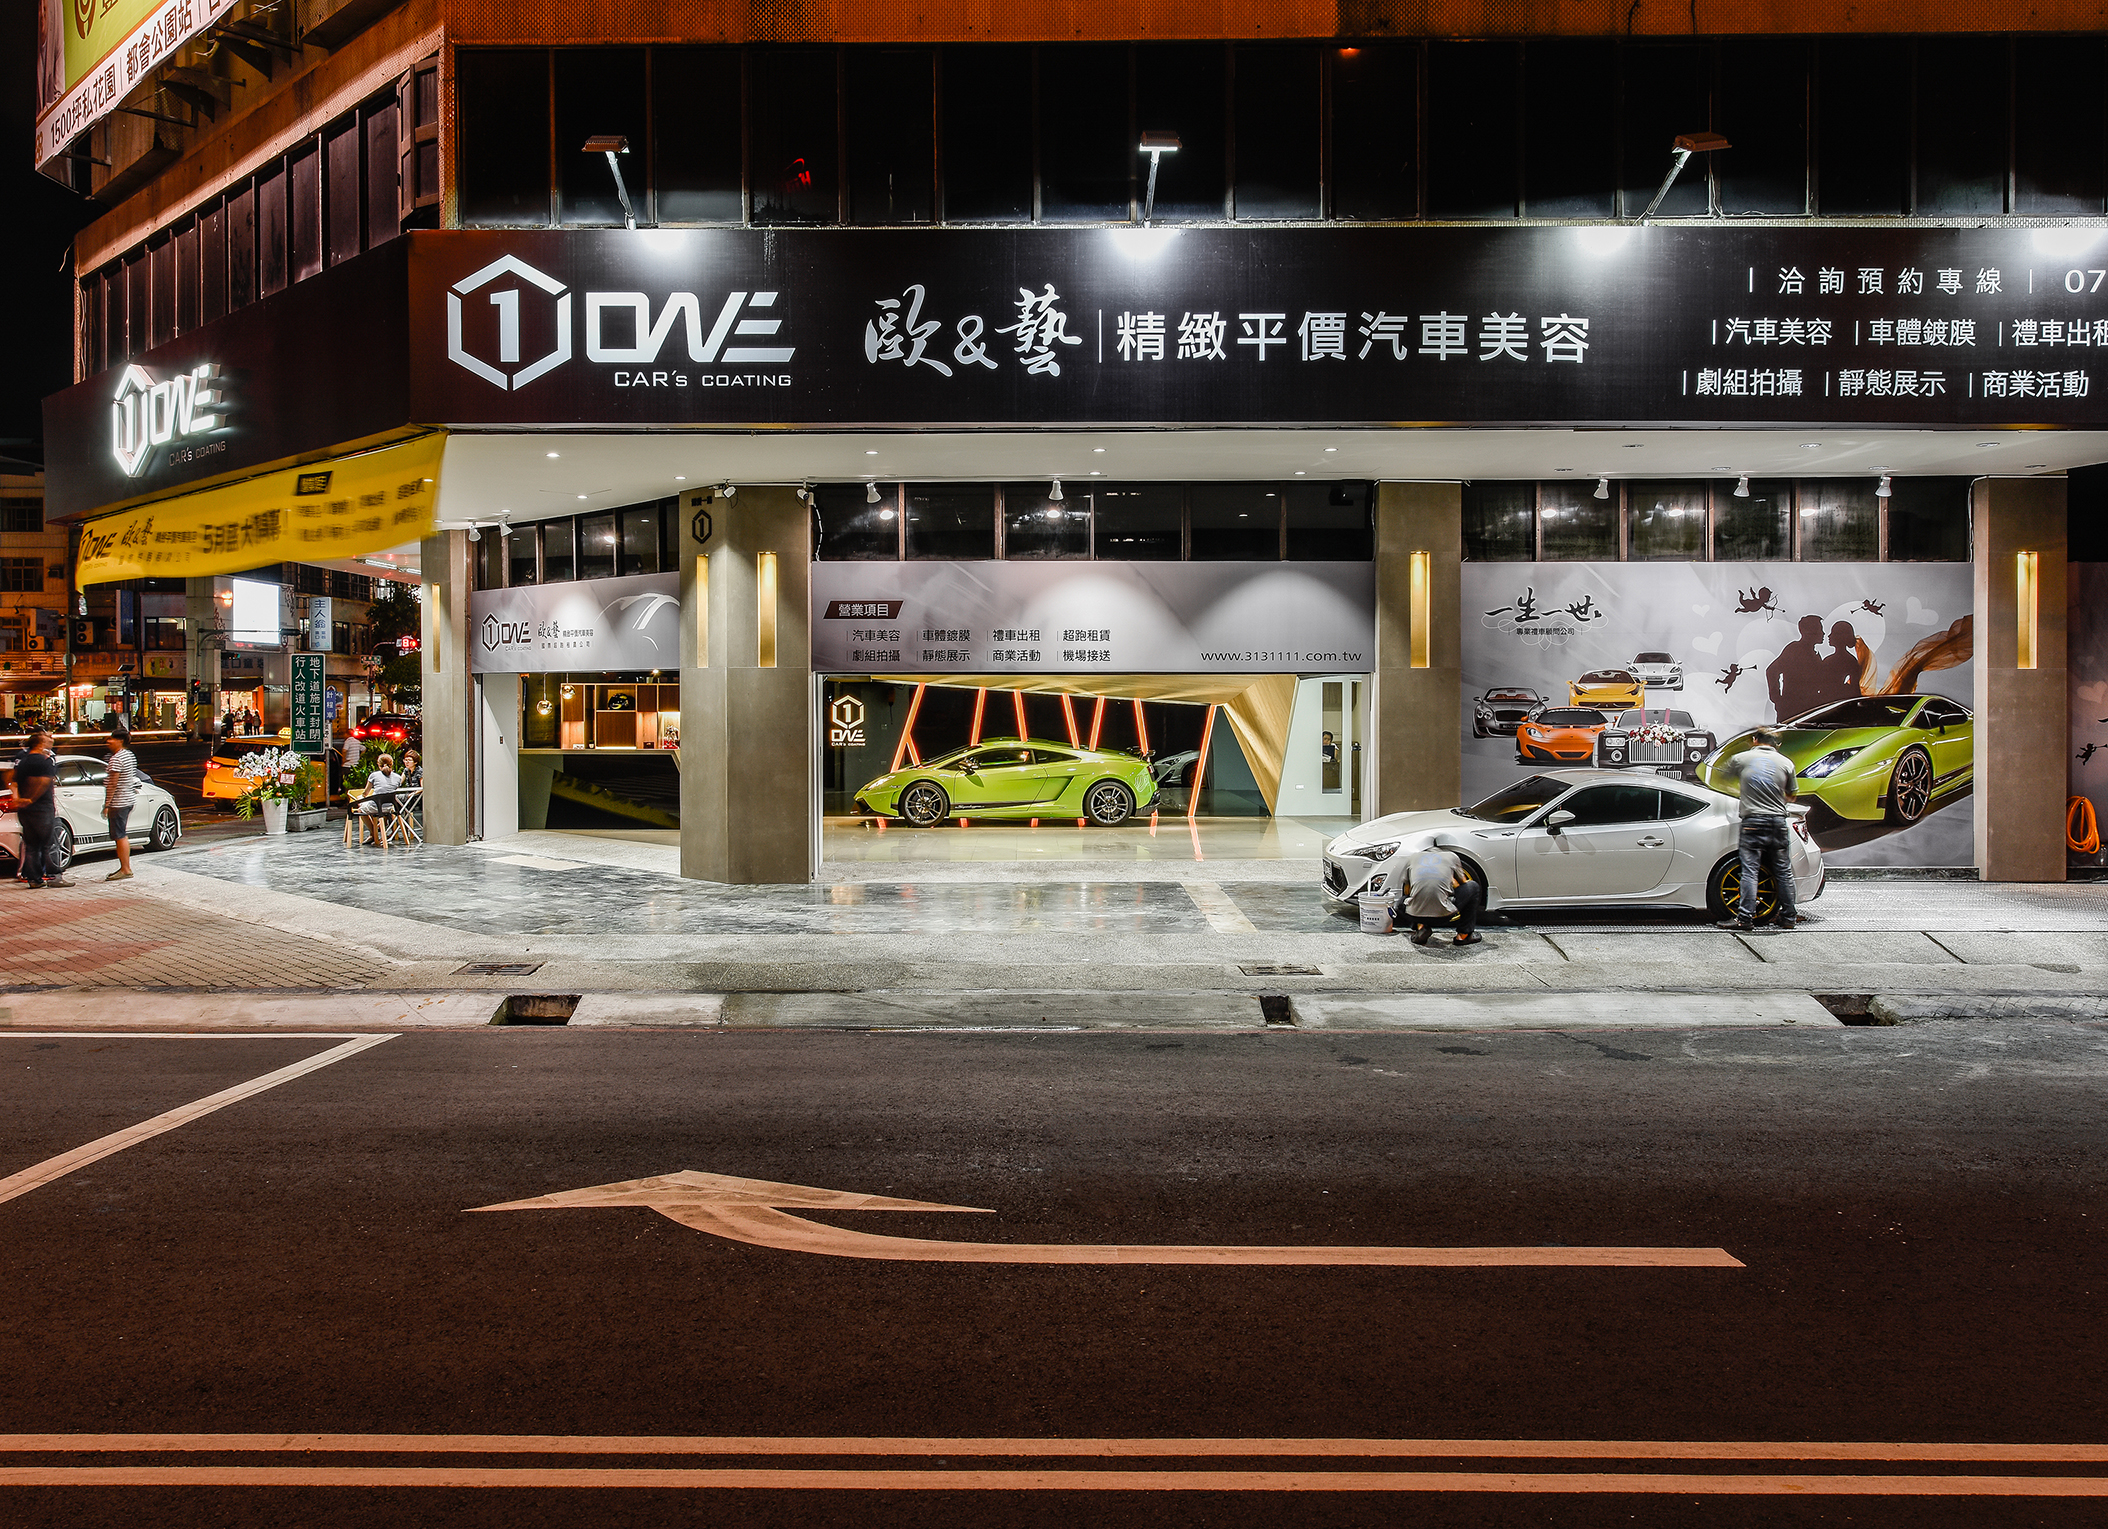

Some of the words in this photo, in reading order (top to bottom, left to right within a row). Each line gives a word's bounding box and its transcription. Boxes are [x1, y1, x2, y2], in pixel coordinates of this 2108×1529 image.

[50, 63, 116, 148] 1500坪私花園
[126, 0, 193, 85] 都會公園站
[1777, 266, 2003, 295] 洽詢預約專線
[2064, 268, 2107, 294] 07
[586, 292, 796, 363] ONE
[1116, 311, 1590, 364] 精緻平價汽車美容
[1724, 317, 1833, 346] 汽車美容
[1867, 317, 1977, 347] 車體鍍膜
[2011, 317, 2108, 347] 禮車出租
[701, 374, 793, 387] COATING
[1695, 368, 1803, 398] 劇組拍攝
[1838, 369, 1947, 398] 靜態展示
[1981, 369, 2090, 398] 商業活動
[195, 440, 227, 459] COATING
[838, 603, 889, 617] 營業項目
[1484, 586, 1595, 622] 一生一世
[852, 629, 901, 642] 汽車美容
[922, 629, 971, 642] 車體鍍膜
[992, 629, 1041, 642] 禮車出租
[1062, 629, 1111, 642] 超跑租賃
[852, 649, 901, 662] 劇組拍攝
[922, 649, 971, 662] 靜態展示
[992, 649, 1041, 662] 商業活動
[1062, 649, 1111, 662] 機場接送
[1200, 651, 1362, 662] www.3131111.com.tw
[294, 656, 306, 740] 行人改道火車站
[309, 656, 321, 740] 地下道施工封閉
[831, 729, 866, 742] ONE
